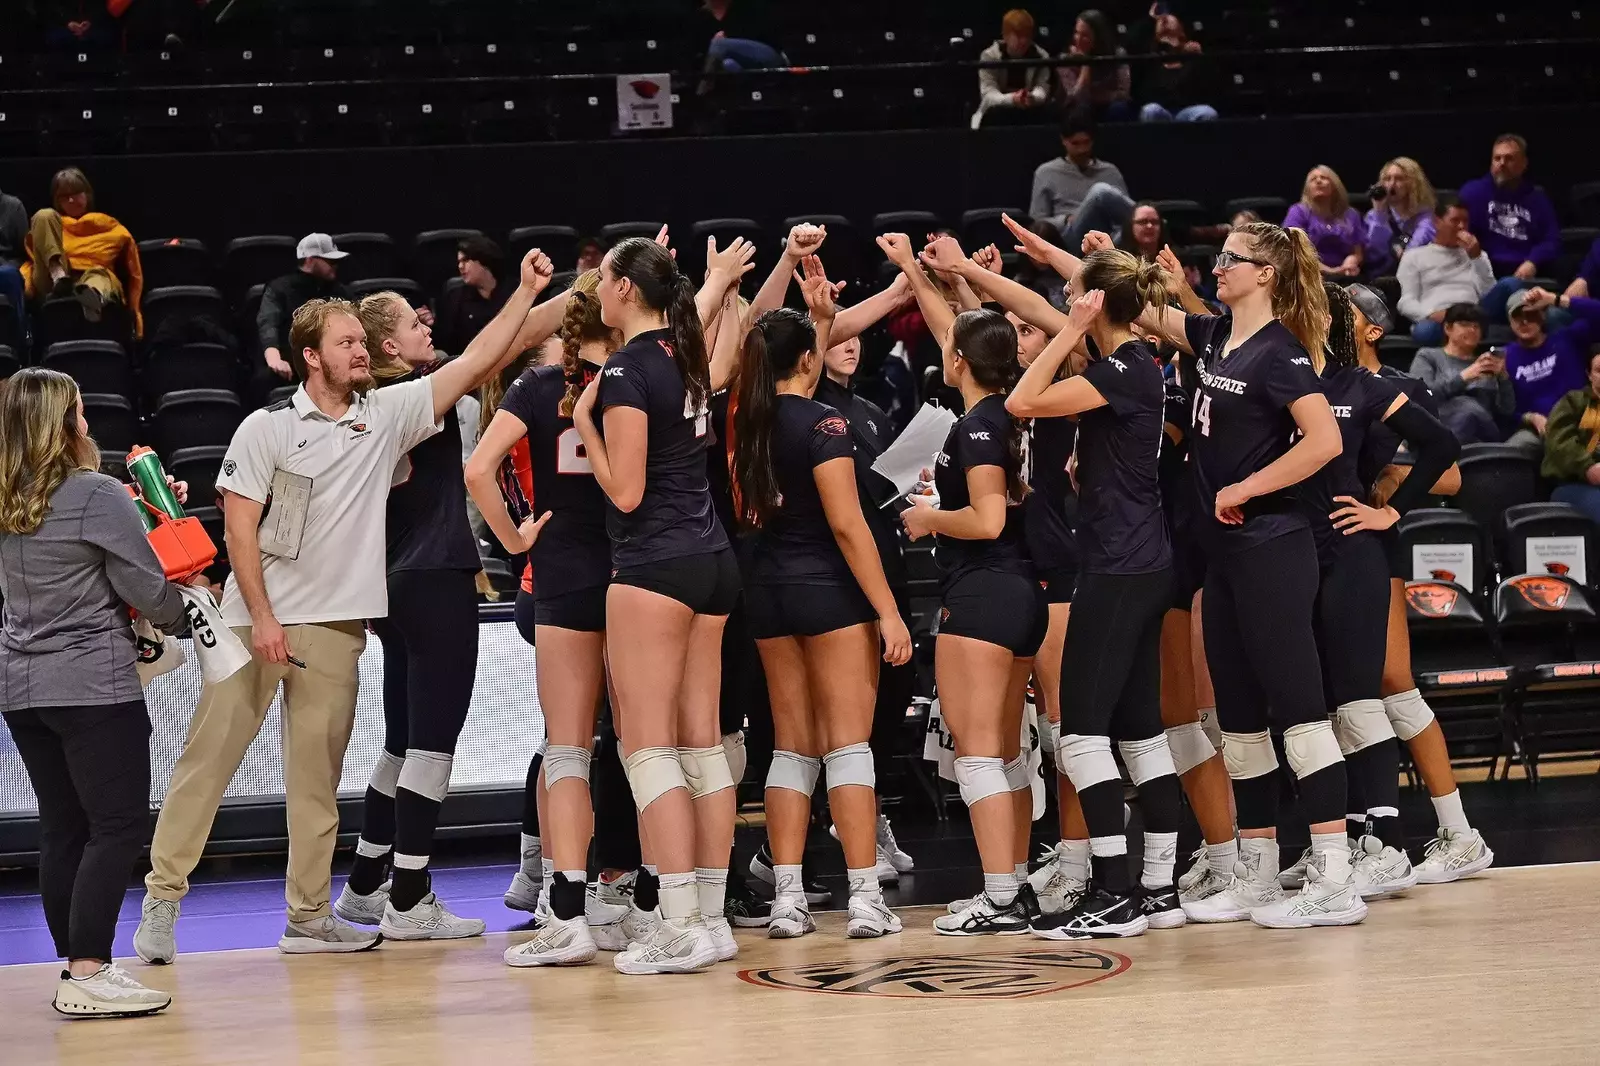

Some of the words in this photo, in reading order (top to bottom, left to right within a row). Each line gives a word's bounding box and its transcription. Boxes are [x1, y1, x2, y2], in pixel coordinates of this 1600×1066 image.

[604, 367, 624, 377] WCC
[1211, 375, 1248, 395] STATE
[969, 431, 990, 441] WCC
